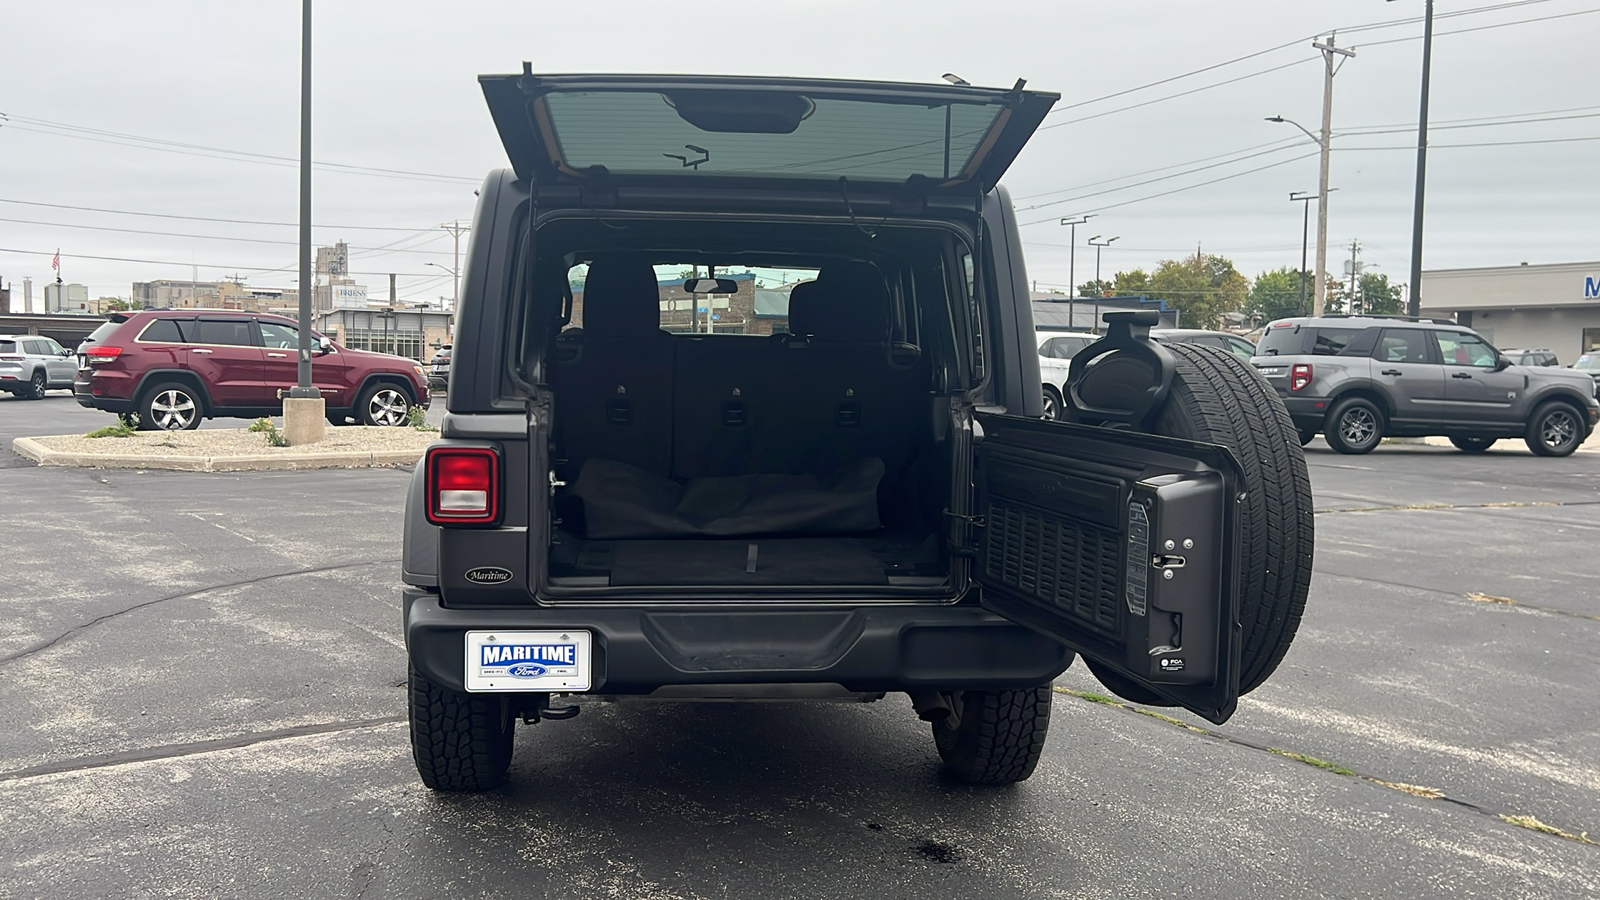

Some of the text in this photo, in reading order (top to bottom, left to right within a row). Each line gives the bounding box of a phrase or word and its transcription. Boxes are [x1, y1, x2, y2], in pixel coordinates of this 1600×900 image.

[340, 289, 366, 297] BRIESS
[470, 571, 508, 580] Maritime
[483, 646, 574, 665] MARITIME
[514, 666, 541, 676] Ford
